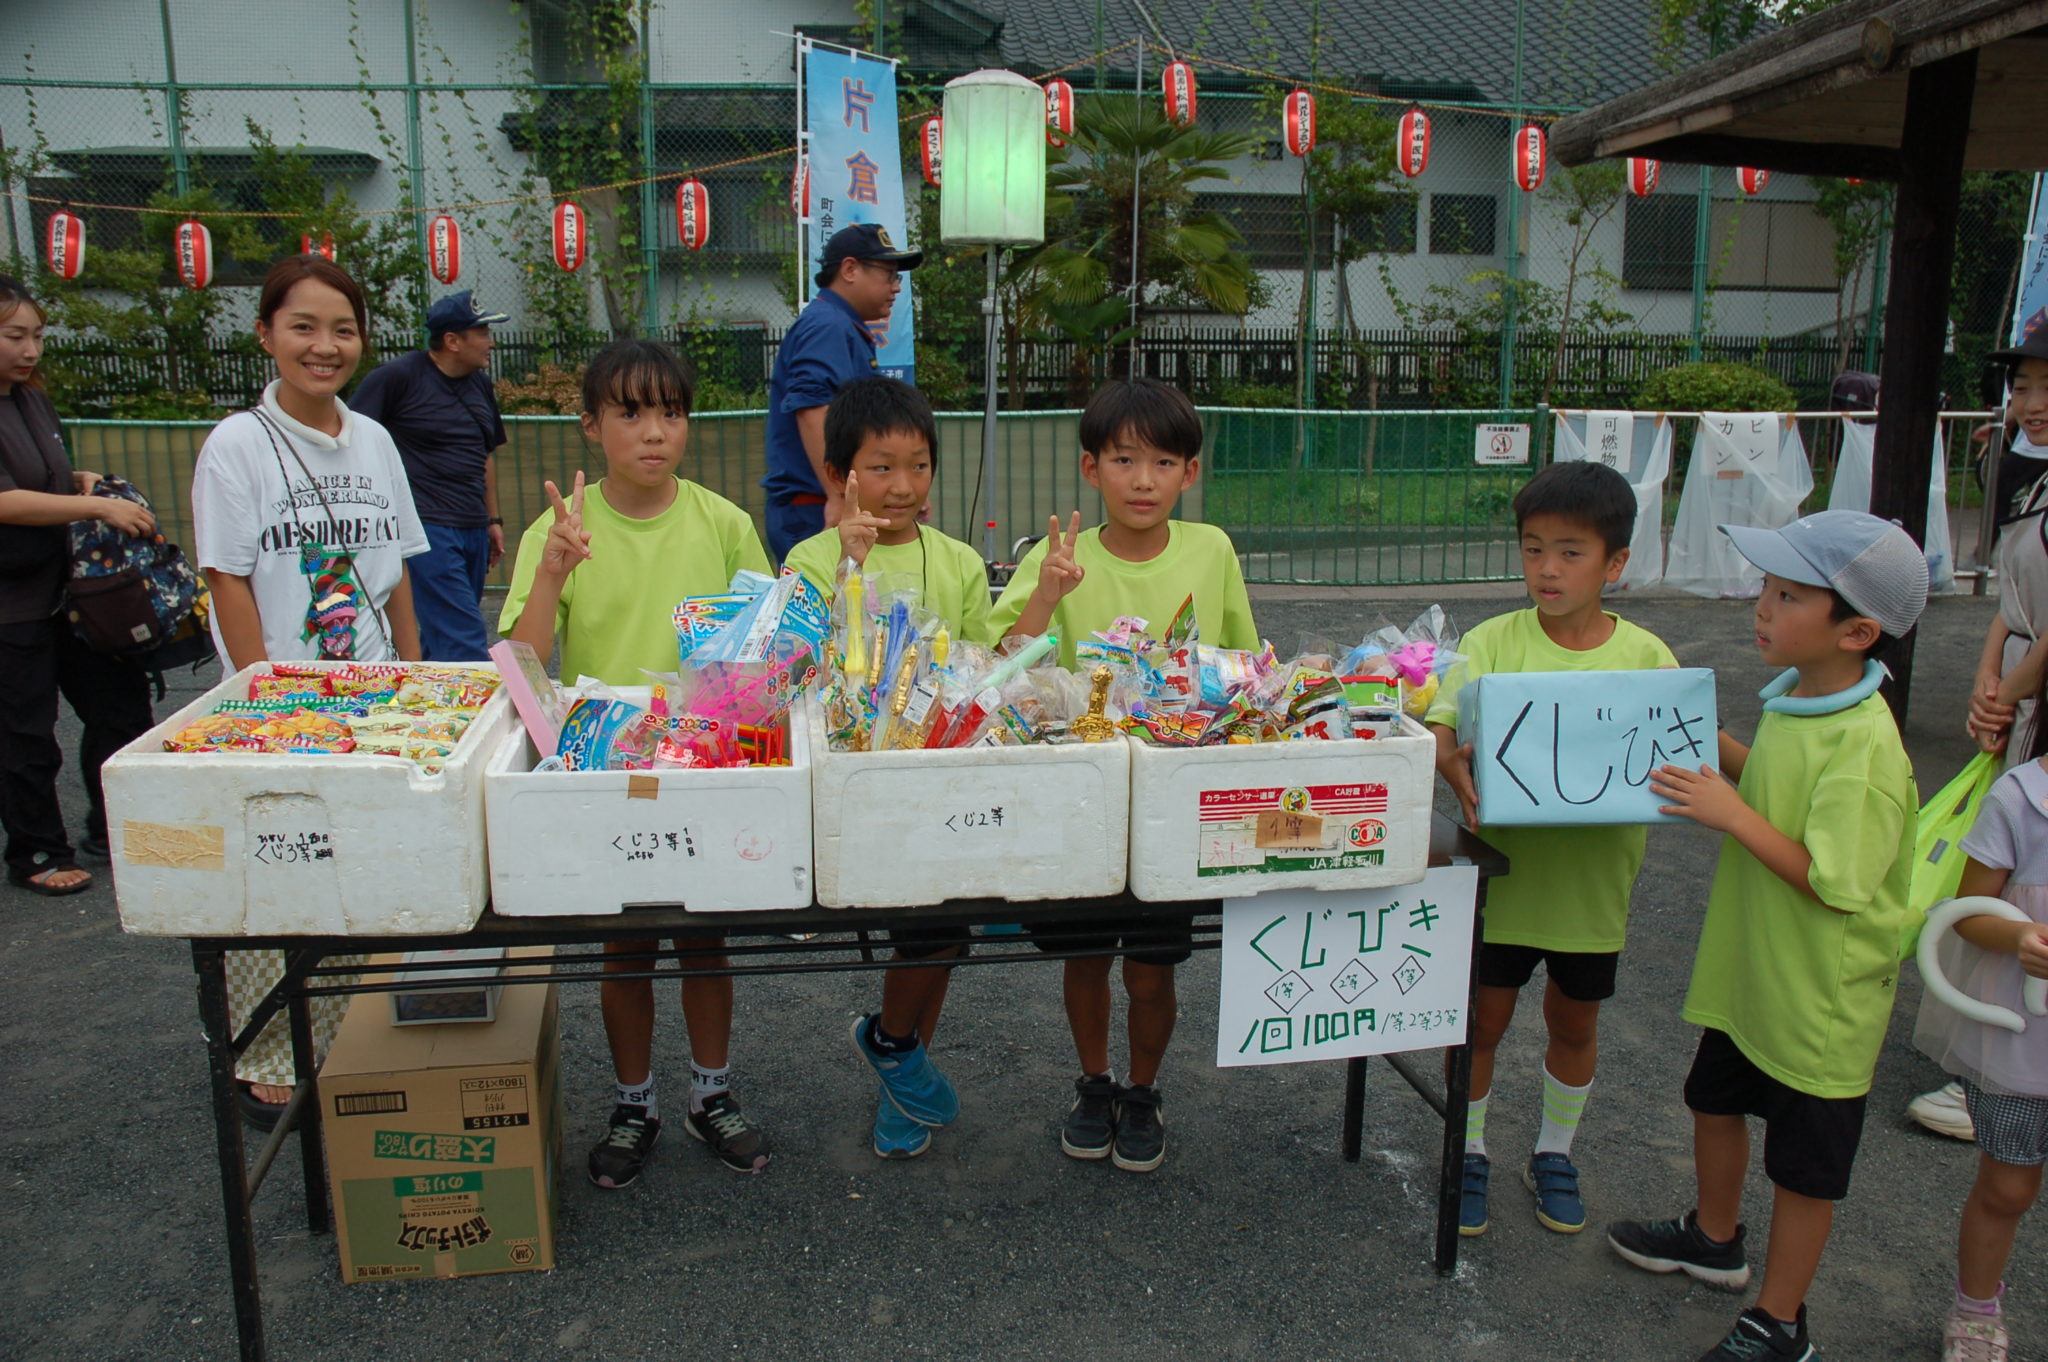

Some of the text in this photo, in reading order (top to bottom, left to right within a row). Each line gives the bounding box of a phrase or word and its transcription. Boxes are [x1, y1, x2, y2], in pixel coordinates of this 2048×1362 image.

[1601, 416, 1620, 468] 可燃物
[294, 474, 372, 494] ALICE IN
[272, 489, 389, 515] WONDERLAND
[261, 517, 369, 553] CHESHIRE
[1495, 700, 1704, 806] くじびき
[1249, 899, 1440, 973] くじびき
[472, 1114, 521, 1128] 12155
[377, 1144, 409, 1156] サイズ
[409, 1134, 492, 1161] 大盛り
[411, 1176, 465, 1194] のり塩
[451, 1207, 485, 1215] KOIKEYA
[396, 1215, 492, 1252] ポテトチップス
